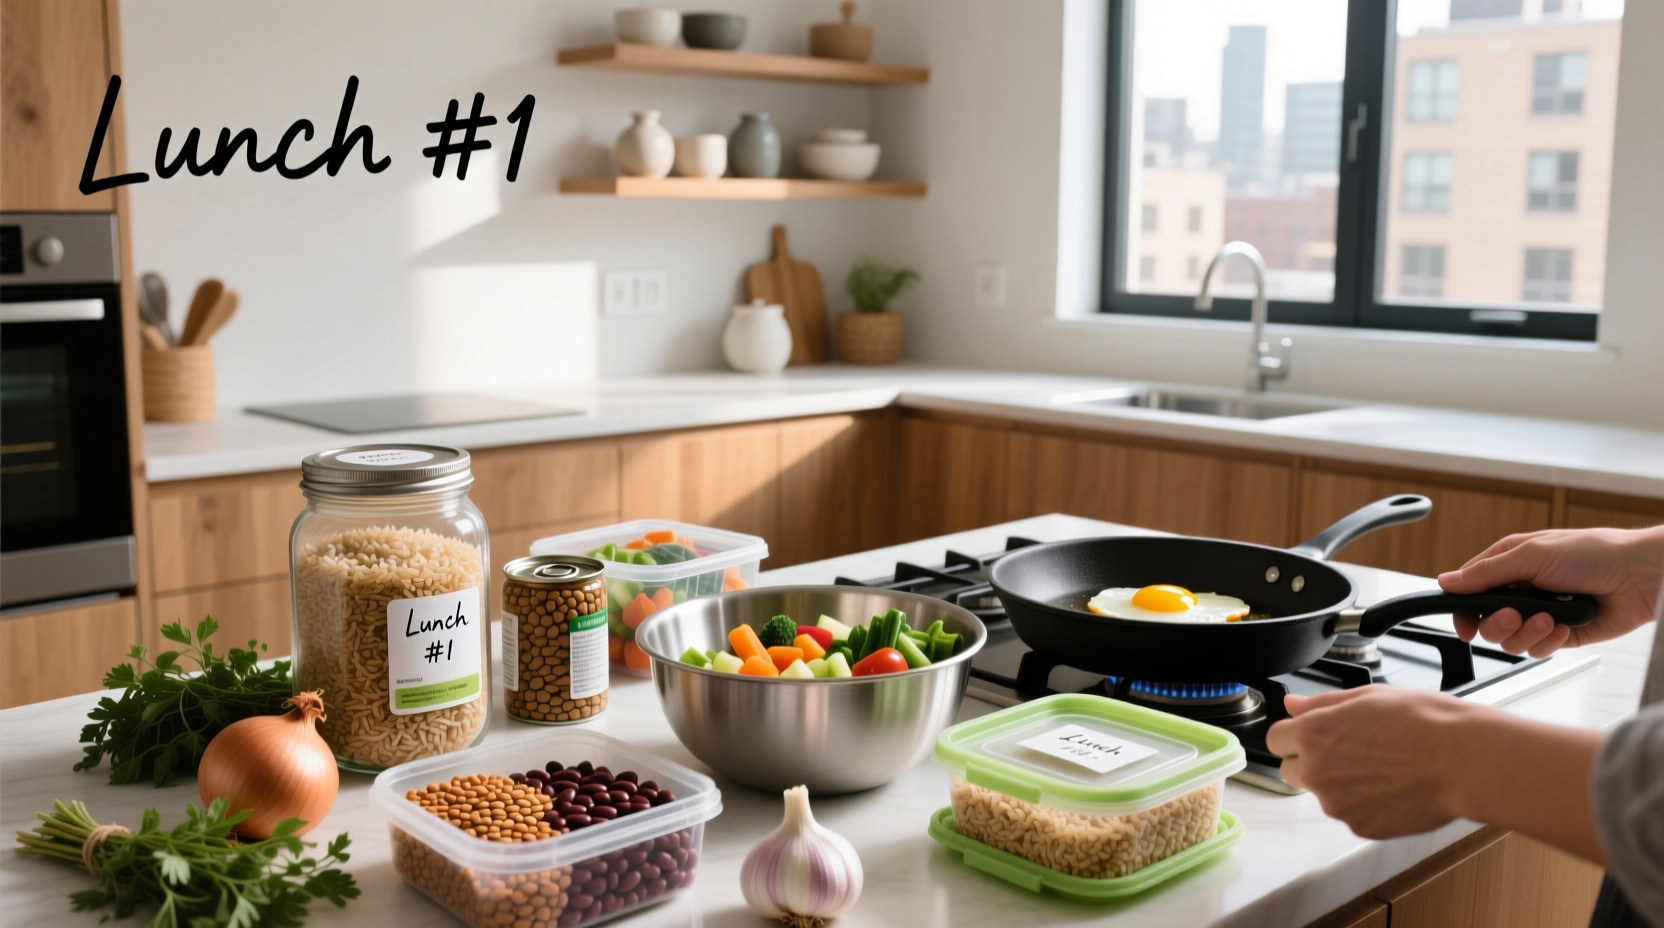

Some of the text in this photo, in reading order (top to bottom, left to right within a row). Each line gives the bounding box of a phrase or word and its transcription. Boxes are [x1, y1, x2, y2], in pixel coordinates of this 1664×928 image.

[406, 600, 468, 638] Lunch
[424, 638, 453, 664] #1
[1059, 734, 1122, 755] Lunch
